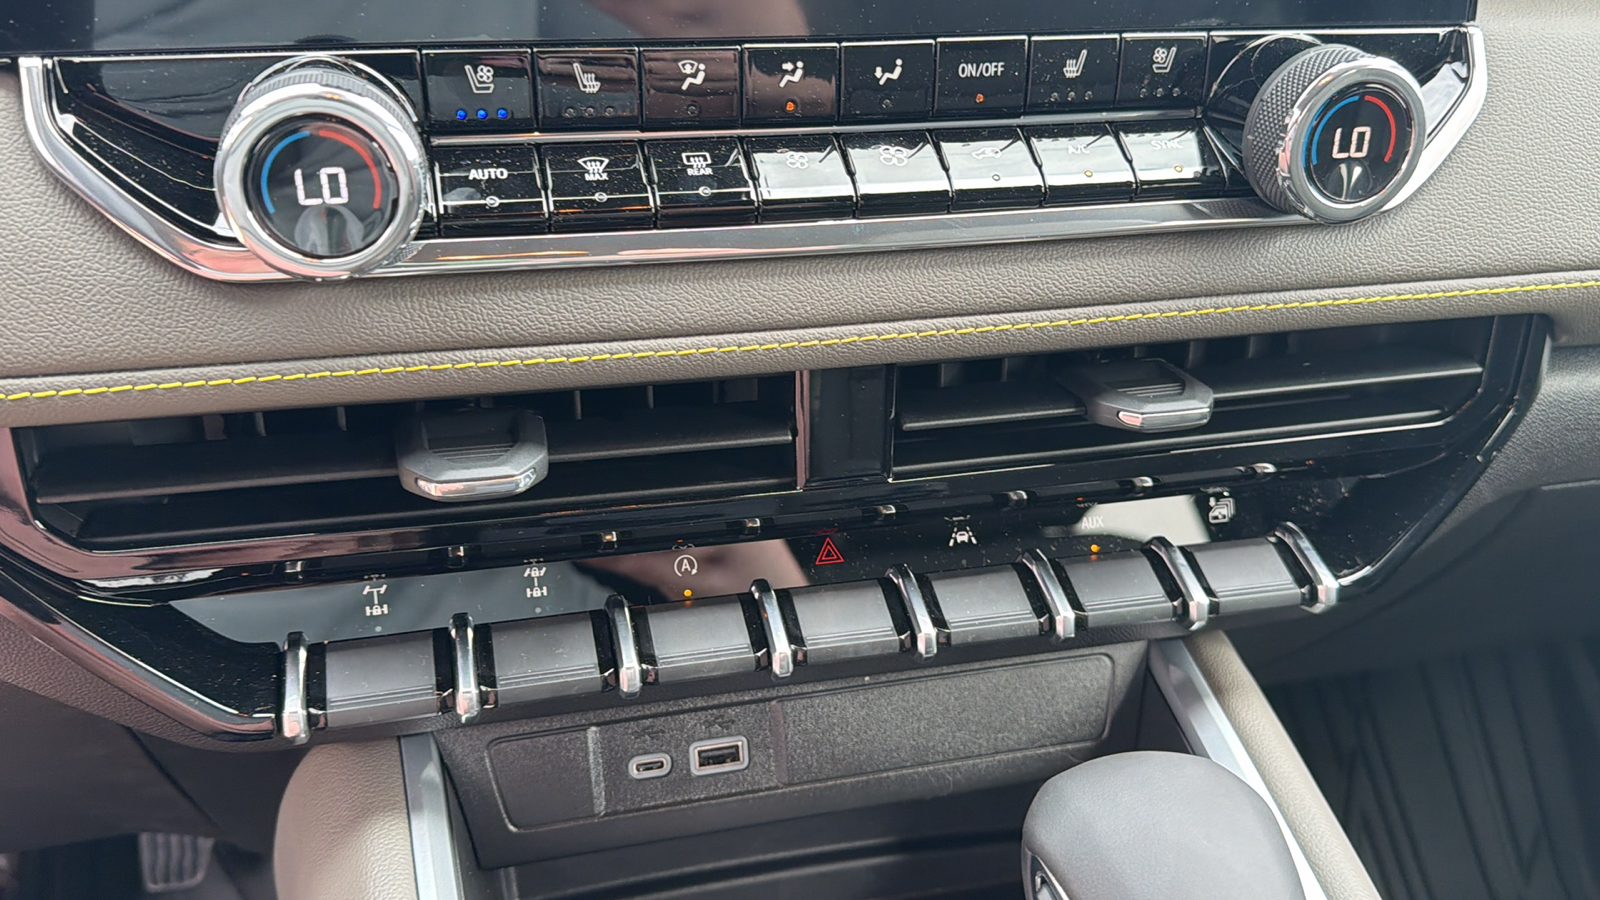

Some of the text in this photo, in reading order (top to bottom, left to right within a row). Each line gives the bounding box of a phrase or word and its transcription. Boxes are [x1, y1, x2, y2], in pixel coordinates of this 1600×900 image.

[958, 62, 1005, 78] ON/OFF
[1150, 138, 1184, 151] SYNC
[1332, 126, 1371, 159] LO
[469, 167, 508, 180] AUTO
[585, 171, 608, 181] MAX
[687, 167, 713, 176] REAR
[294, 166, 349, 206] LO
[1081, 515, 1105, 530] AUX
